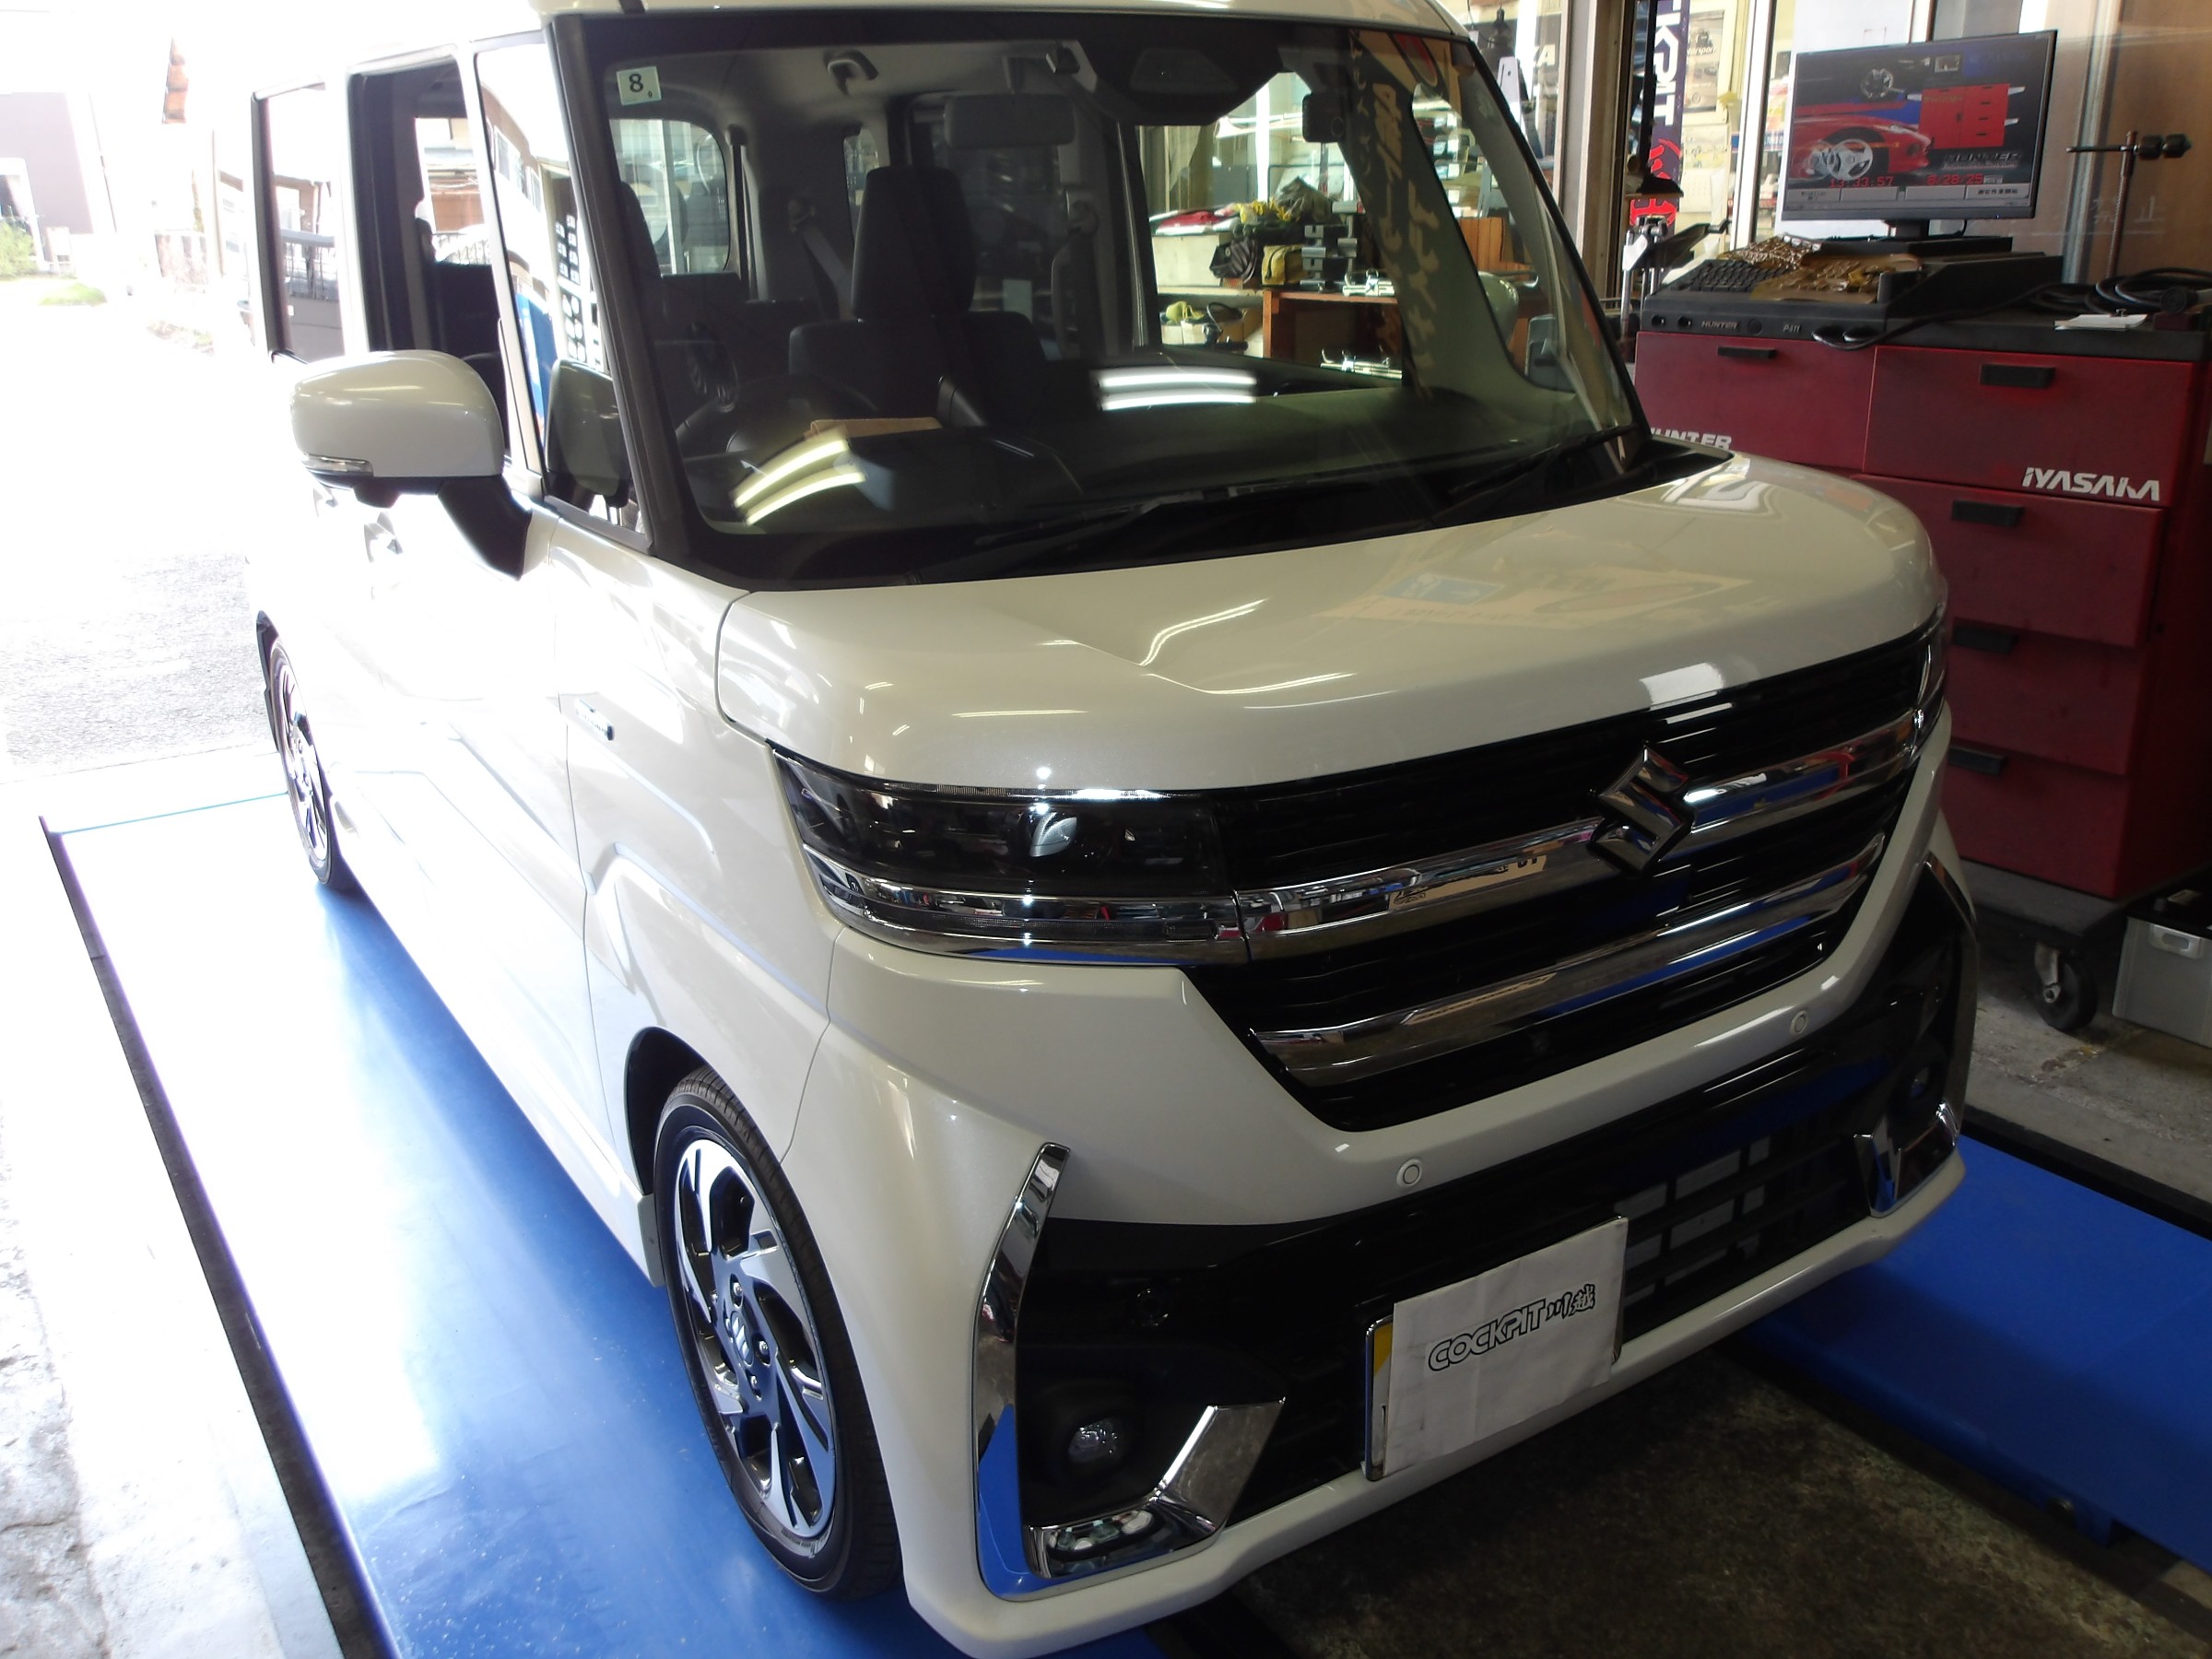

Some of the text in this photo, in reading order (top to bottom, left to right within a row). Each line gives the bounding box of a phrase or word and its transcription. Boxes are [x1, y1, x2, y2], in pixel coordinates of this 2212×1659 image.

[1653, 0, 1681, 127] KPIT
[629, 74, 643, 92] 8
[1700, 319, 1738, 330] HUNTER
[1650, 427, 1733, 451] UNTER
[1428, 1283, 1596, 1372] COCKPIT 川越
